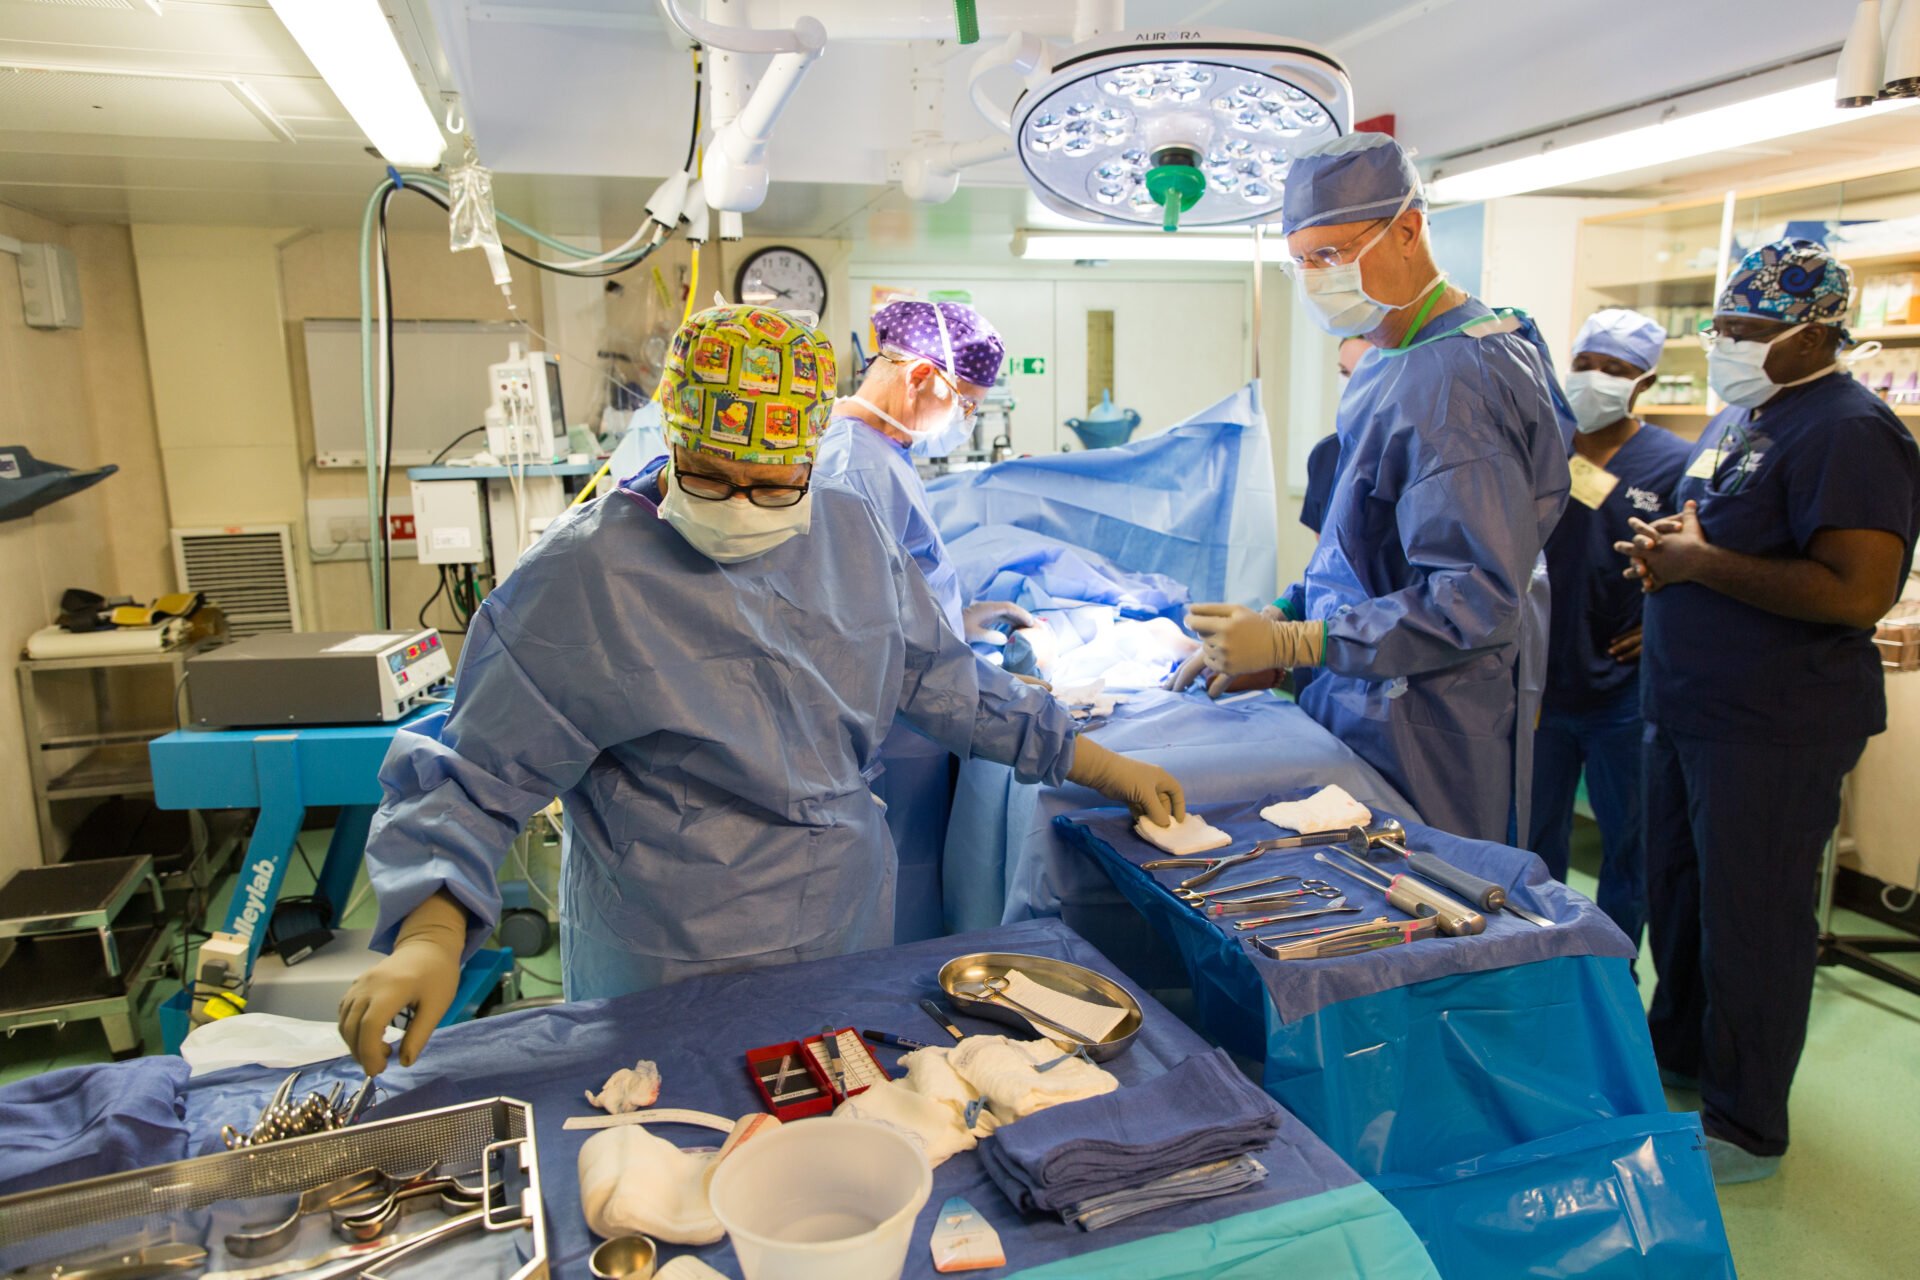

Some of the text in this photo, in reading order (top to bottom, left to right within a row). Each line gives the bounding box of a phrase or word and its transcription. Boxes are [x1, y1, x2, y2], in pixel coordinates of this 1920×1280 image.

[762, 258, 773, 269] 11
[779, 256, 791, 268] 12
[233, 859, 275, 936] lleylab
